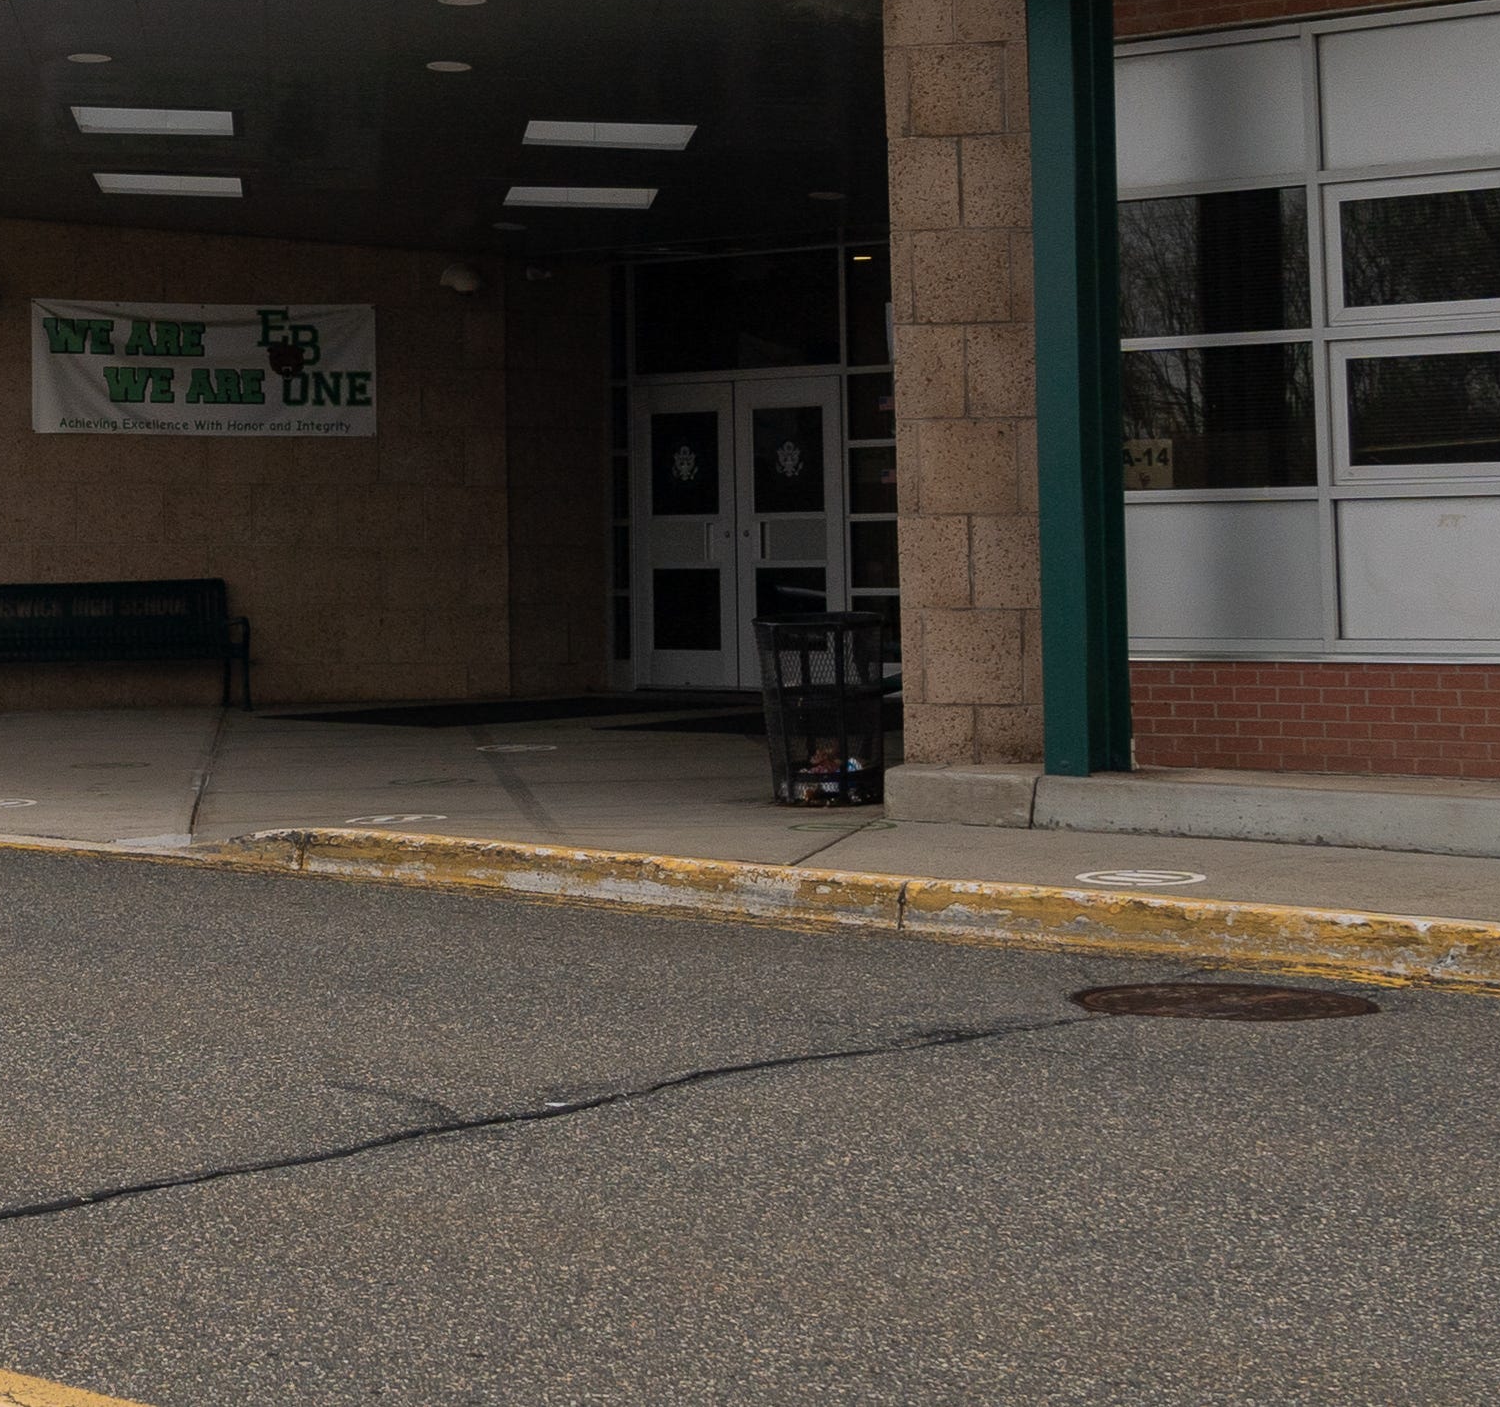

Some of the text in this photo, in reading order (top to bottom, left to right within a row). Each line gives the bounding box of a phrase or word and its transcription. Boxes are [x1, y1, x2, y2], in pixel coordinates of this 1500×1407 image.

[43, 317, 206, 356] WE ARE
[103, 366, 372, 407] WE ARE ONE
[59, 417, 352, 434] Achieving Excellence With Honor and Integrity
